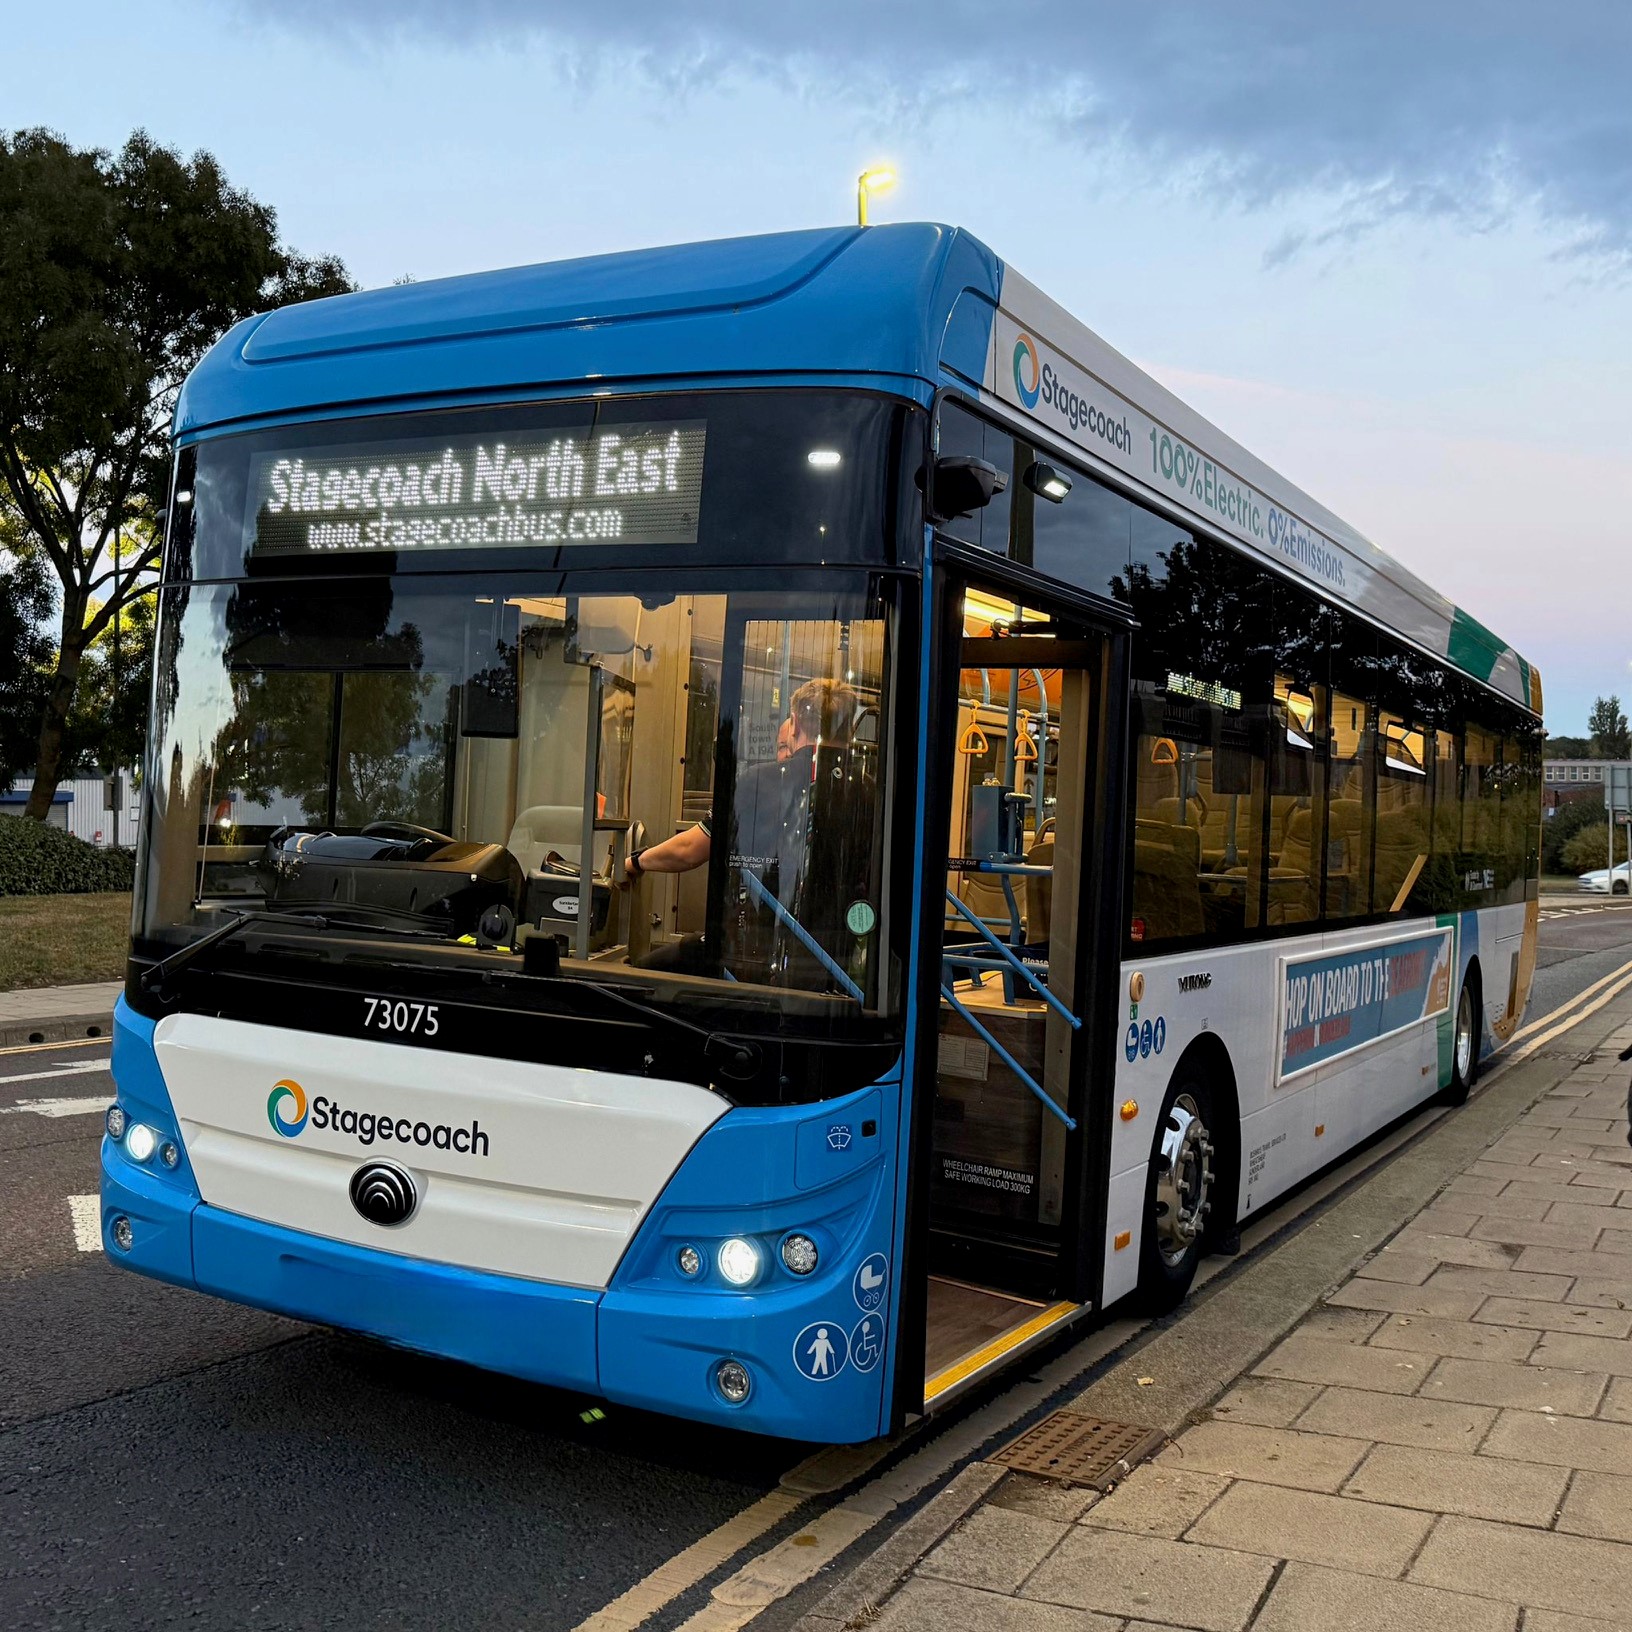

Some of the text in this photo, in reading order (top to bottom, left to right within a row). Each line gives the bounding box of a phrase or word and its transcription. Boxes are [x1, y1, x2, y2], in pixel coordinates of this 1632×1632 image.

[1041, 363, 1132, 456] Stagecoach
[268, 430, 681, 513] Stagecoach North East
[307, 505, 623, 550] www.stagecoachbus.com
[729, 855, 764, 863] EMERGENCY
[1178, 972, 1212, 994] YUTONG
[1285, 976, 1307, 1030] HOP
[1308, 972, 1325, 1023] ON
[1325, 964, 1359, 1018] BOARD
[1361, 961, 1373, 1006] TO
[1374, 958, 1390, 1002] THE
[364, 997, 439, 1036] 73075
[311, 1096, 489, 1157] Stagecoach
[943, 1158, 1034, 1185] WHEELCHAIR RAMP MAXIMUM
[944, 1169, 1030, 1194] SAFE WORKING LOAD 300KG
